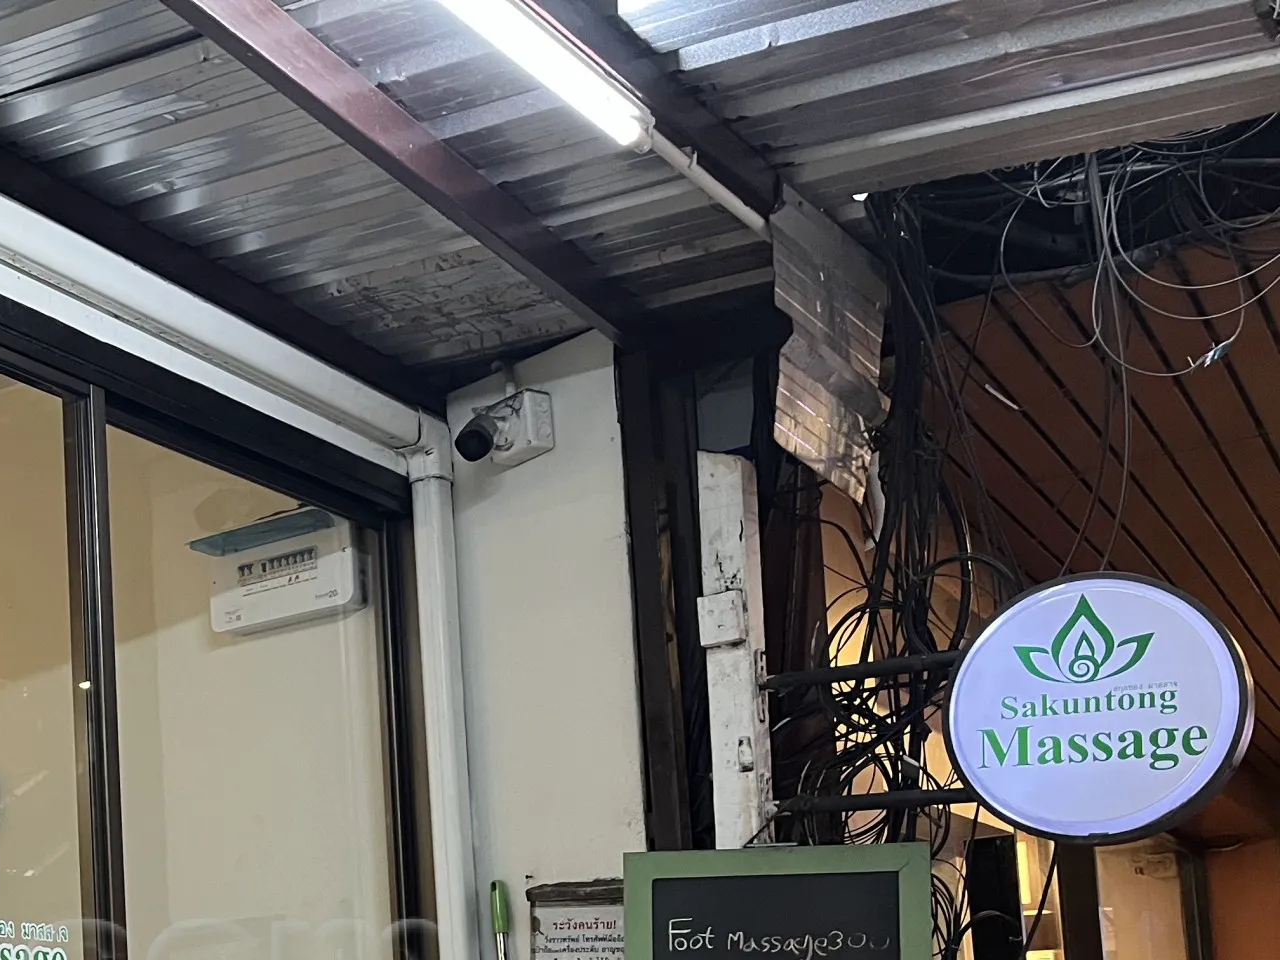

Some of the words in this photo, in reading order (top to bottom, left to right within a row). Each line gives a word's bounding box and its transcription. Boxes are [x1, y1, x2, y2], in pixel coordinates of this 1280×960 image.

[1000, 688, 1178, 721] Sakuntong
[977, 723, 1208, 771] Massage
[553, 917, 616, 930] ระวังคนร้าย!
[668, 917, 715, 953] Foot
